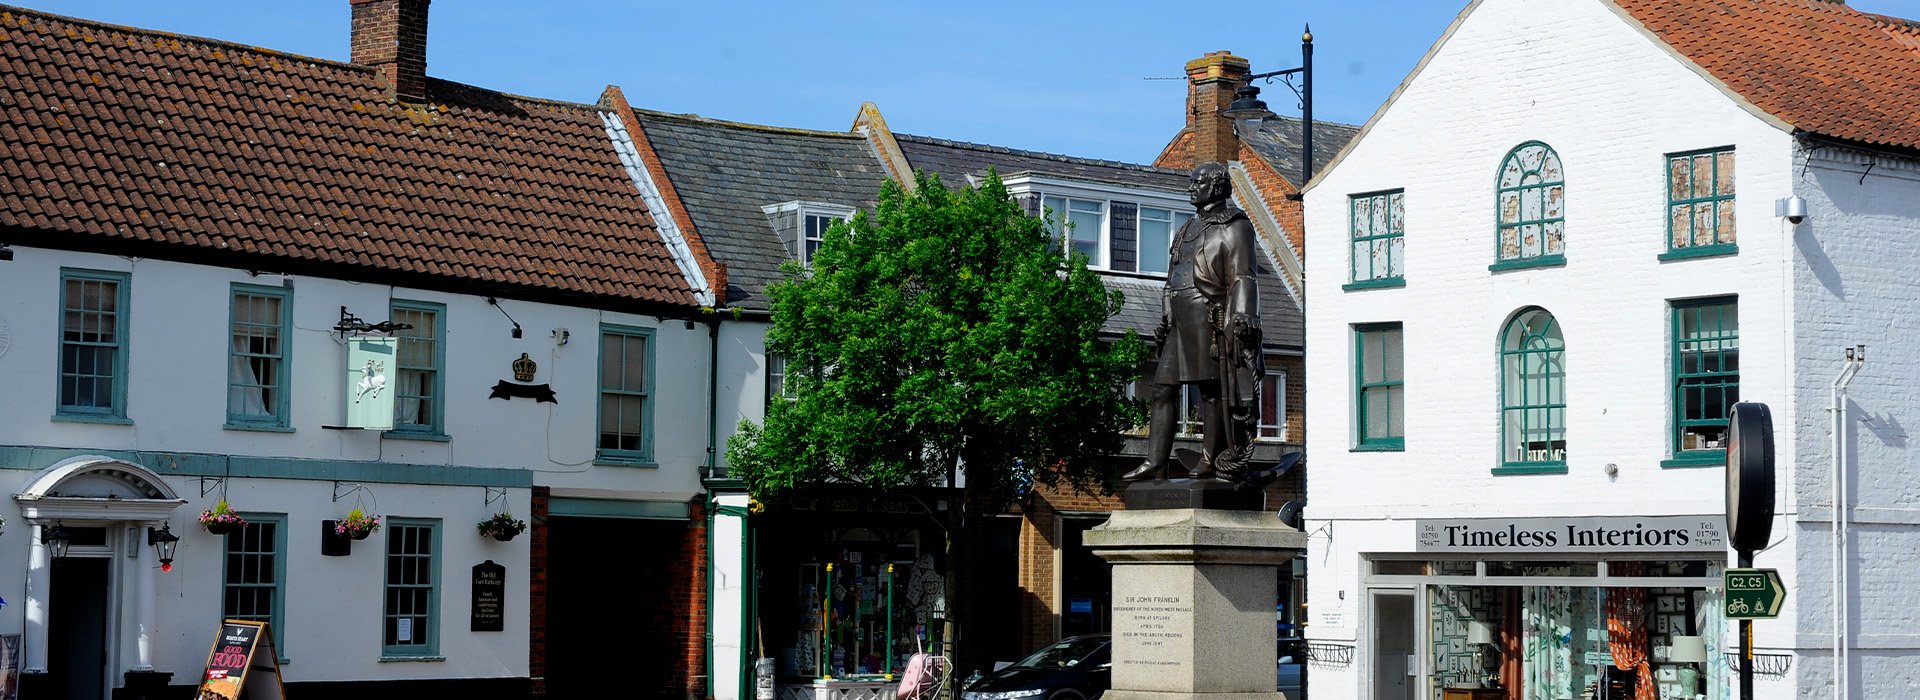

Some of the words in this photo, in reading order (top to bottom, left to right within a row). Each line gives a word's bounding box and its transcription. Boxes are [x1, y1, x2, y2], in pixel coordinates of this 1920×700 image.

[1700, 522, 1714, 530] Tel:
[1443, 523, 1558, 547] Timeless
[1566, 522, 1689, 546] Interiors
[1694, 538, 1721, 546] 754477
[1748, 577, 1762, 587] C5
[223, 645, 243, 654] GOOD
[211, 652, 247, 668] FOOD
